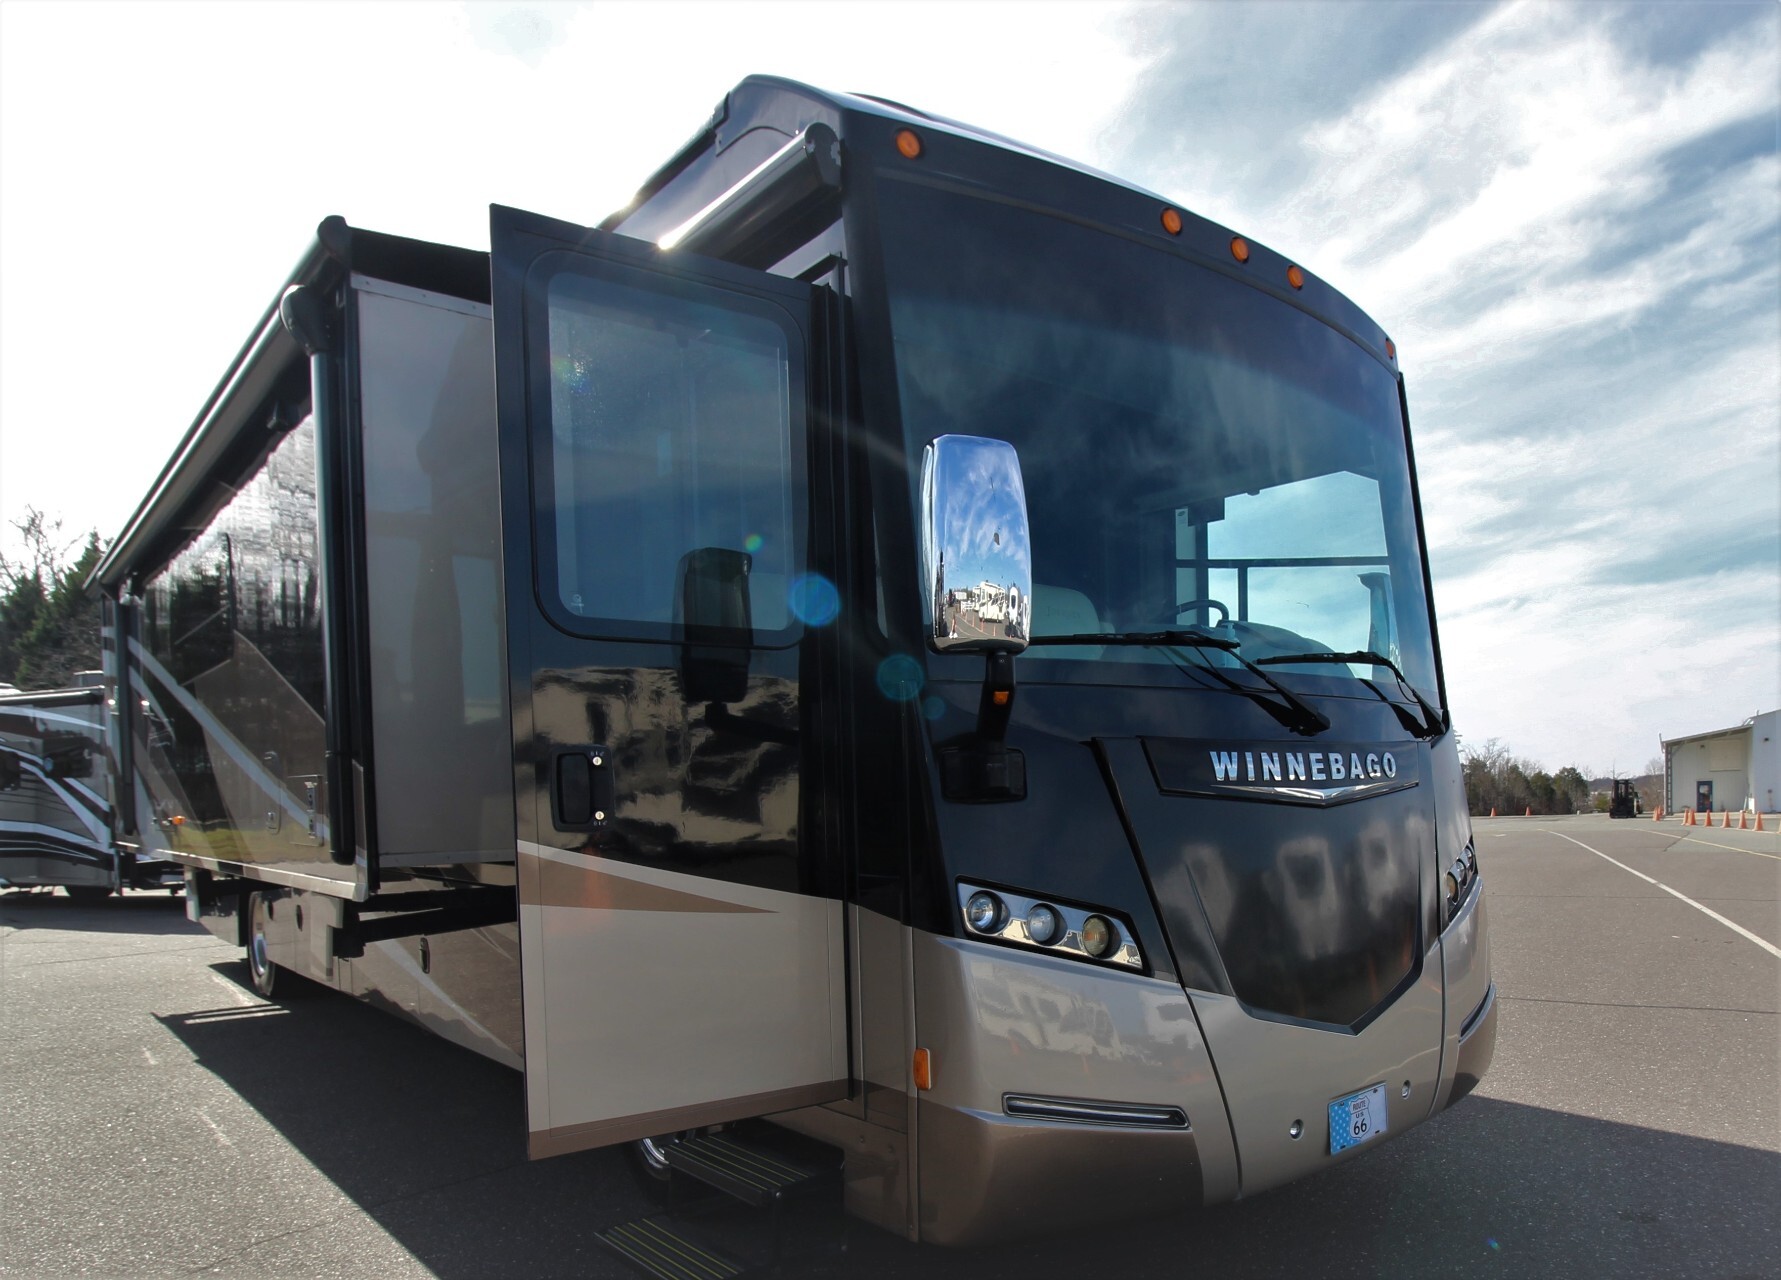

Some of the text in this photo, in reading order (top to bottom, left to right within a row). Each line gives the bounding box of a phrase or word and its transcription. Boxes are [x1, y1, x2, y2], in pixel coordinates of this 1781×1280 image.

[1209, 751, 1397, 782] WINNEBAGO
[1352, 1100, 1366, 1111] ROUTE
[1353, 1118, 1367, 1135] 66
